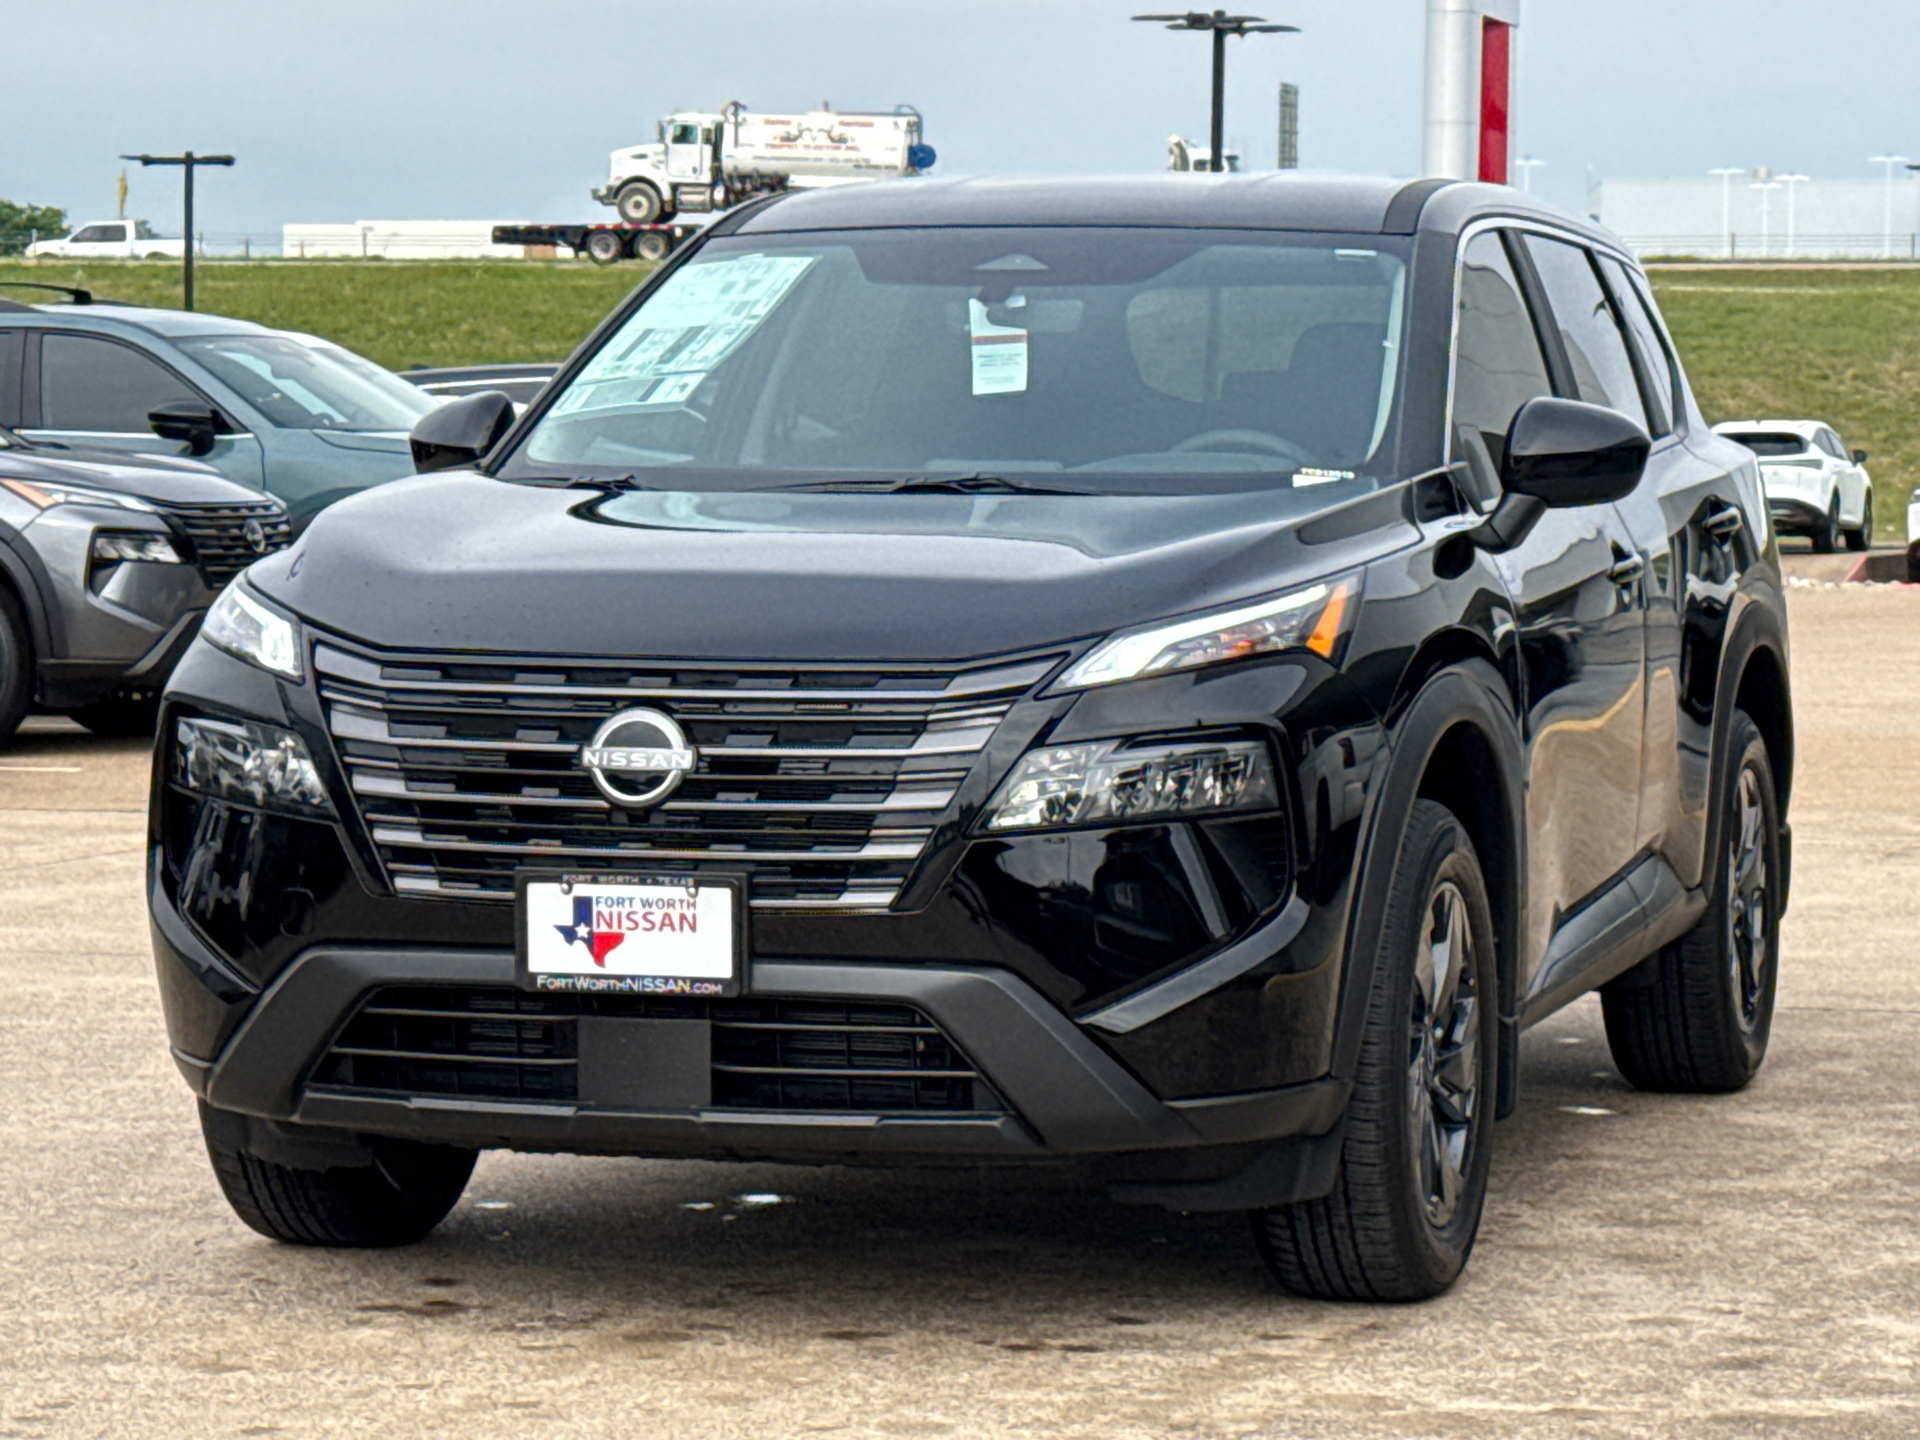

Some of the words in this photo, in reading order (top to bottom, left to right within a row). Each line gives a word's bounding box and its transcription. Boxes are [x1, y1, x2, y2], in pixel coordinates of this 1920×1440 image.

[584, 750, 690, 768] NISSAN
[595, 896, 636, 909] FORT
[640, 897, 697, 911] WORTH
[595, 910, 697, 933] NISSAN
